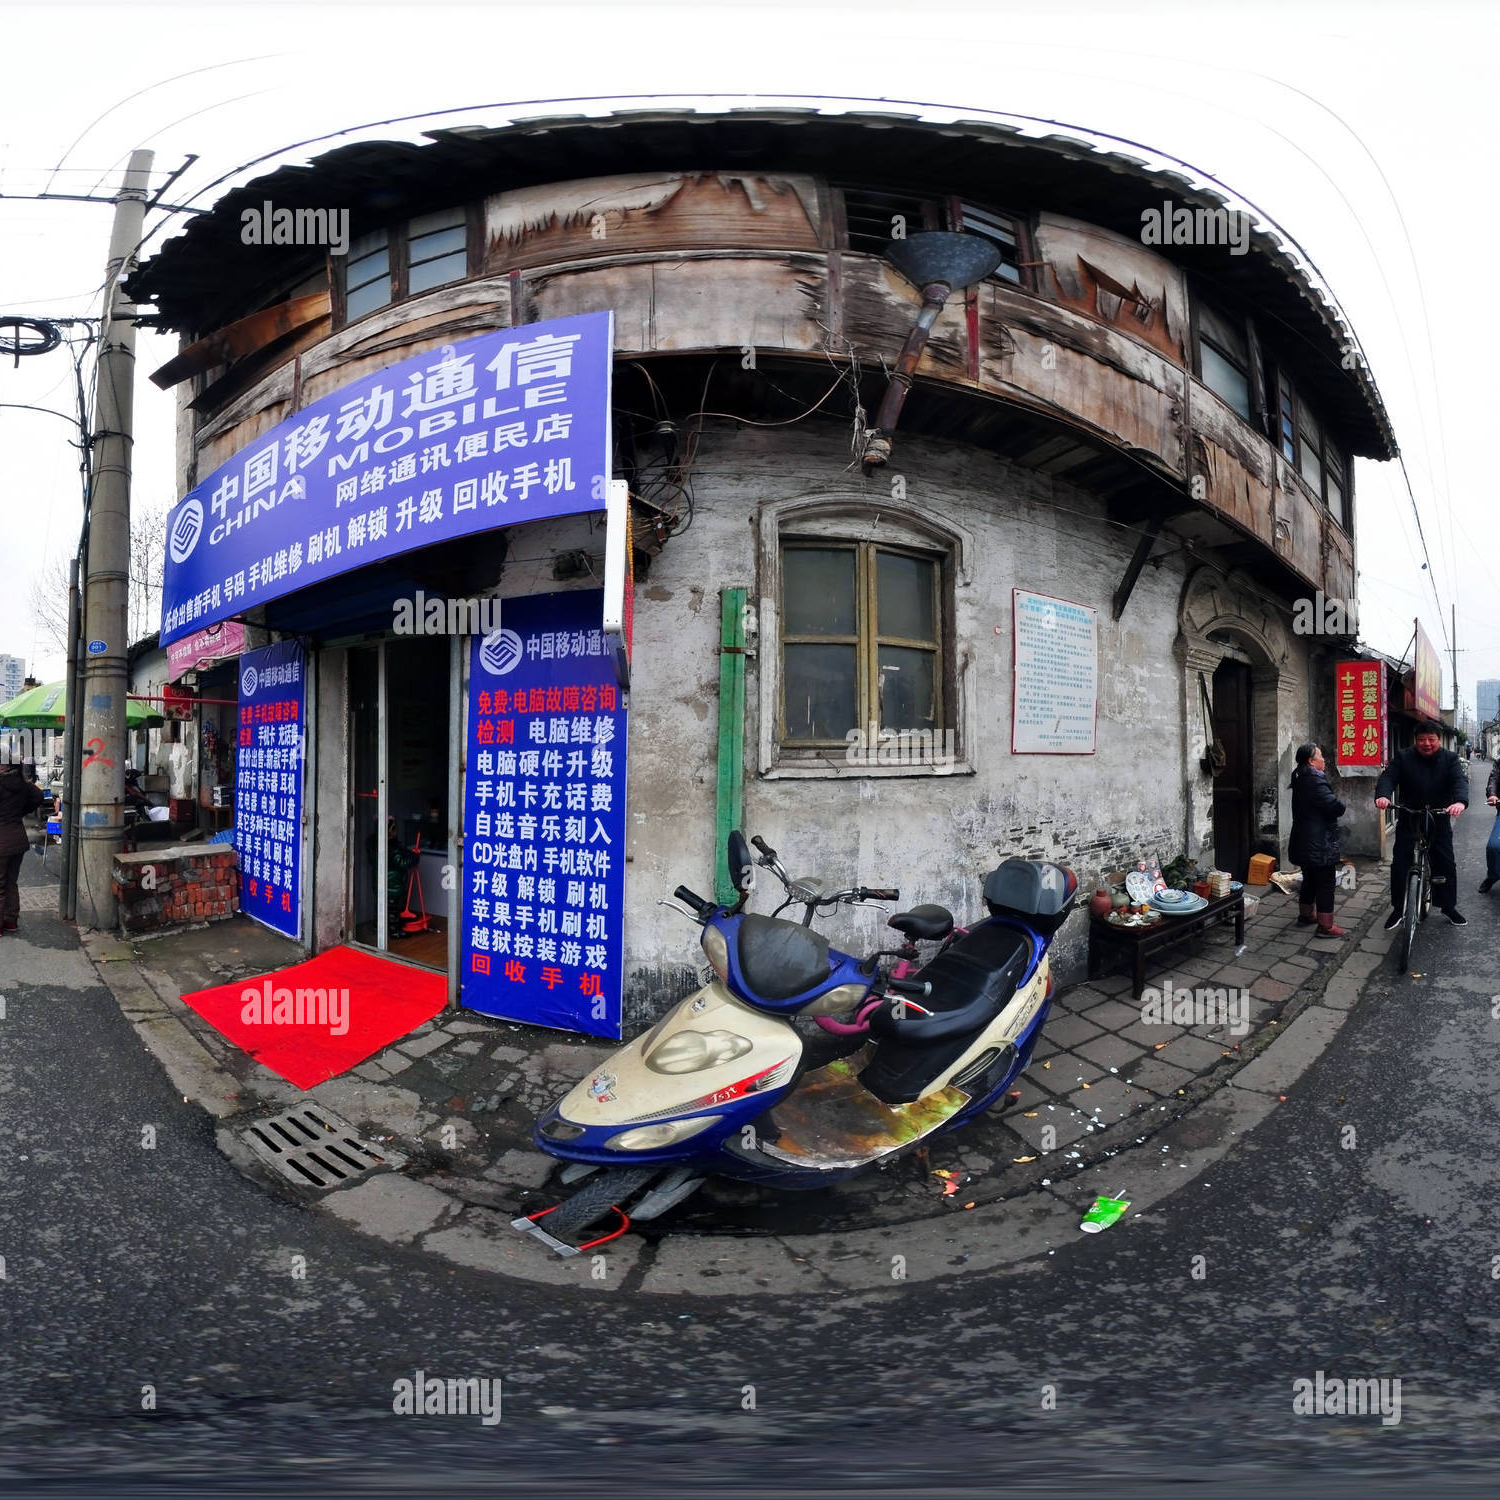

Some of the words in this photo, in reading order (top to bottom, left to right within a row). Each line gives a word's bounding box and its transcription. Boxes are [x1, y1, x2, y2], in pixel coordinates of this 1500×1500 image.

[210, 334, 581, 520] 中国移动通信
[209, 477, 302, 545] CHINA
[328, 382, 568, 477] MOBILE
[336, 413, 573, 508] 网络通讯便民店
[164, 580, 221, 636] 低价出售新手机
[223, 569, 246, 599] 号码
[248, 543, 303, 590] 手机维修
[307, 524, 342, 565] 刷机
[347, 507, 388, 551] 解锁
[395, 493, 443, 533] 升级
[453, 457, 576, 515] 回收手机
[258, 661, 300, 689] 中国移动通信
[478, 684, 616, 715] 免费:电脑故障咨询
[1362, 670, 1378, 720] 酸菜鱼
[477, 720, 514, 745] 检测
[529, 715, 615, 745] 电脑维修
[1341, 671, 1356, 757] 十三香龙虾
[83, 737, 115, 768] 2
[258, 725, 275, 746] 手机卡
[278, 723, 298, 746] 充话费
[1362, 724, 1378, 757] 小炒
[238, 769, 256, 790] 内存卡
[258, 771, 278, 793] 读卡器
[280, 772, 296, 795] 耳机
[477, 750, 614, 778] 电脑硬件升级
[238, 790, 257, 812] 充电器
[261, 793, 276, 816] 电池
[475, 780, 613, 812] 手机卡充话费
[475, 810, 612, 845] 自选音乐刻入
[236, 831, 293, 867] 苹果手机刷机
[472, 841, 538, 871] CD光盘内
[542, 847, 611, 878] 手机软件
[472, 870, 508, 898] 升级
[517, 874, 556, 905] 解锁
[566, 880, 608, 910] 刷机
[471, 898, 608, 940] 苹果手机刷机
[471, 925, 607, 970] 越狱按装游戏
[472, 953, 604, 997] 回收手机
